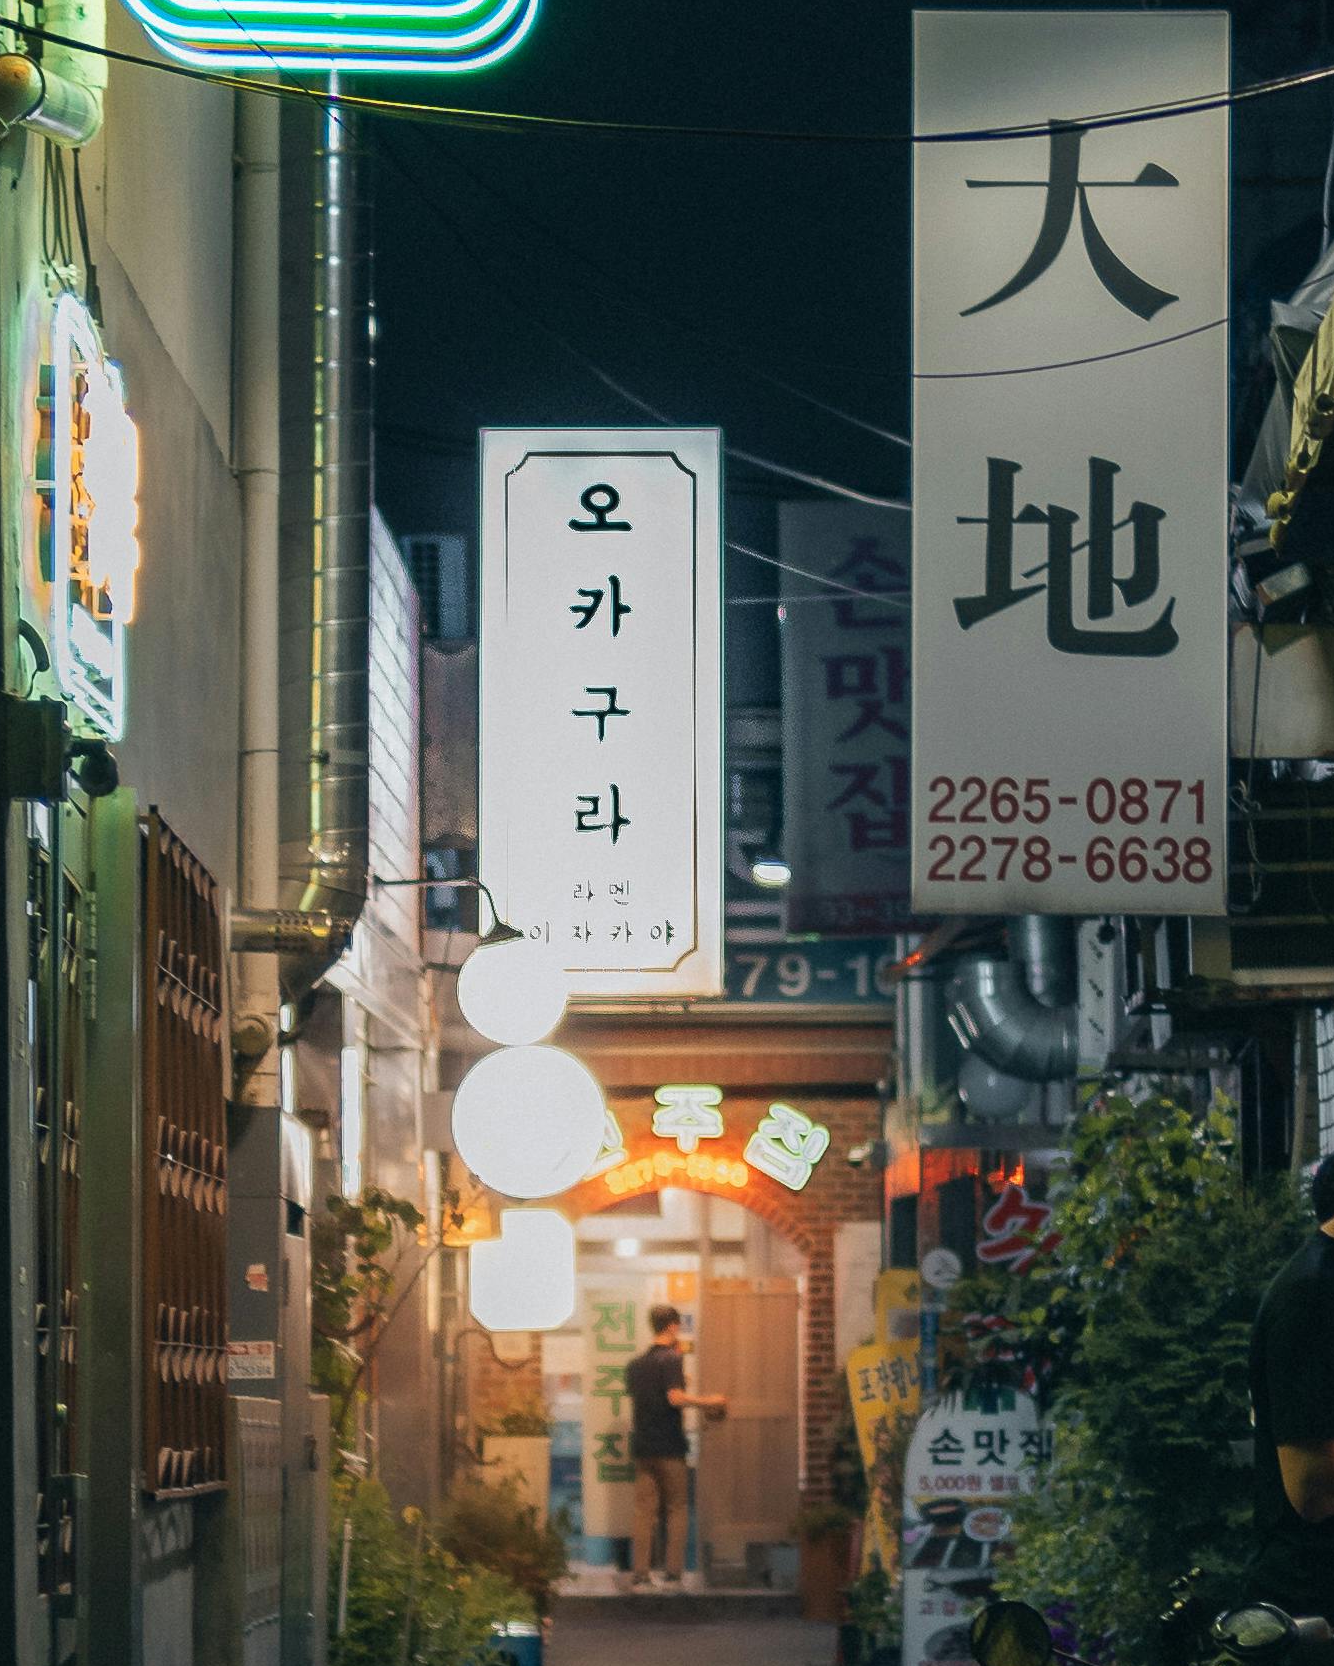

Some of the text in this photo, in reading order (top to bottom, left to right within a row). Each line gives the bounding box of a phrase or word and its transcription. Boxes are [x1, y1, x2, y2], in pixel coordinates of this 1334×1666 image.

[952, 118, 1180, 658] 大地
[568, 483, 633, 846] 오카구라
[927, 777, 1205, 825] 2265-0871
[927, 836, 1213, 884] 2278-6638
